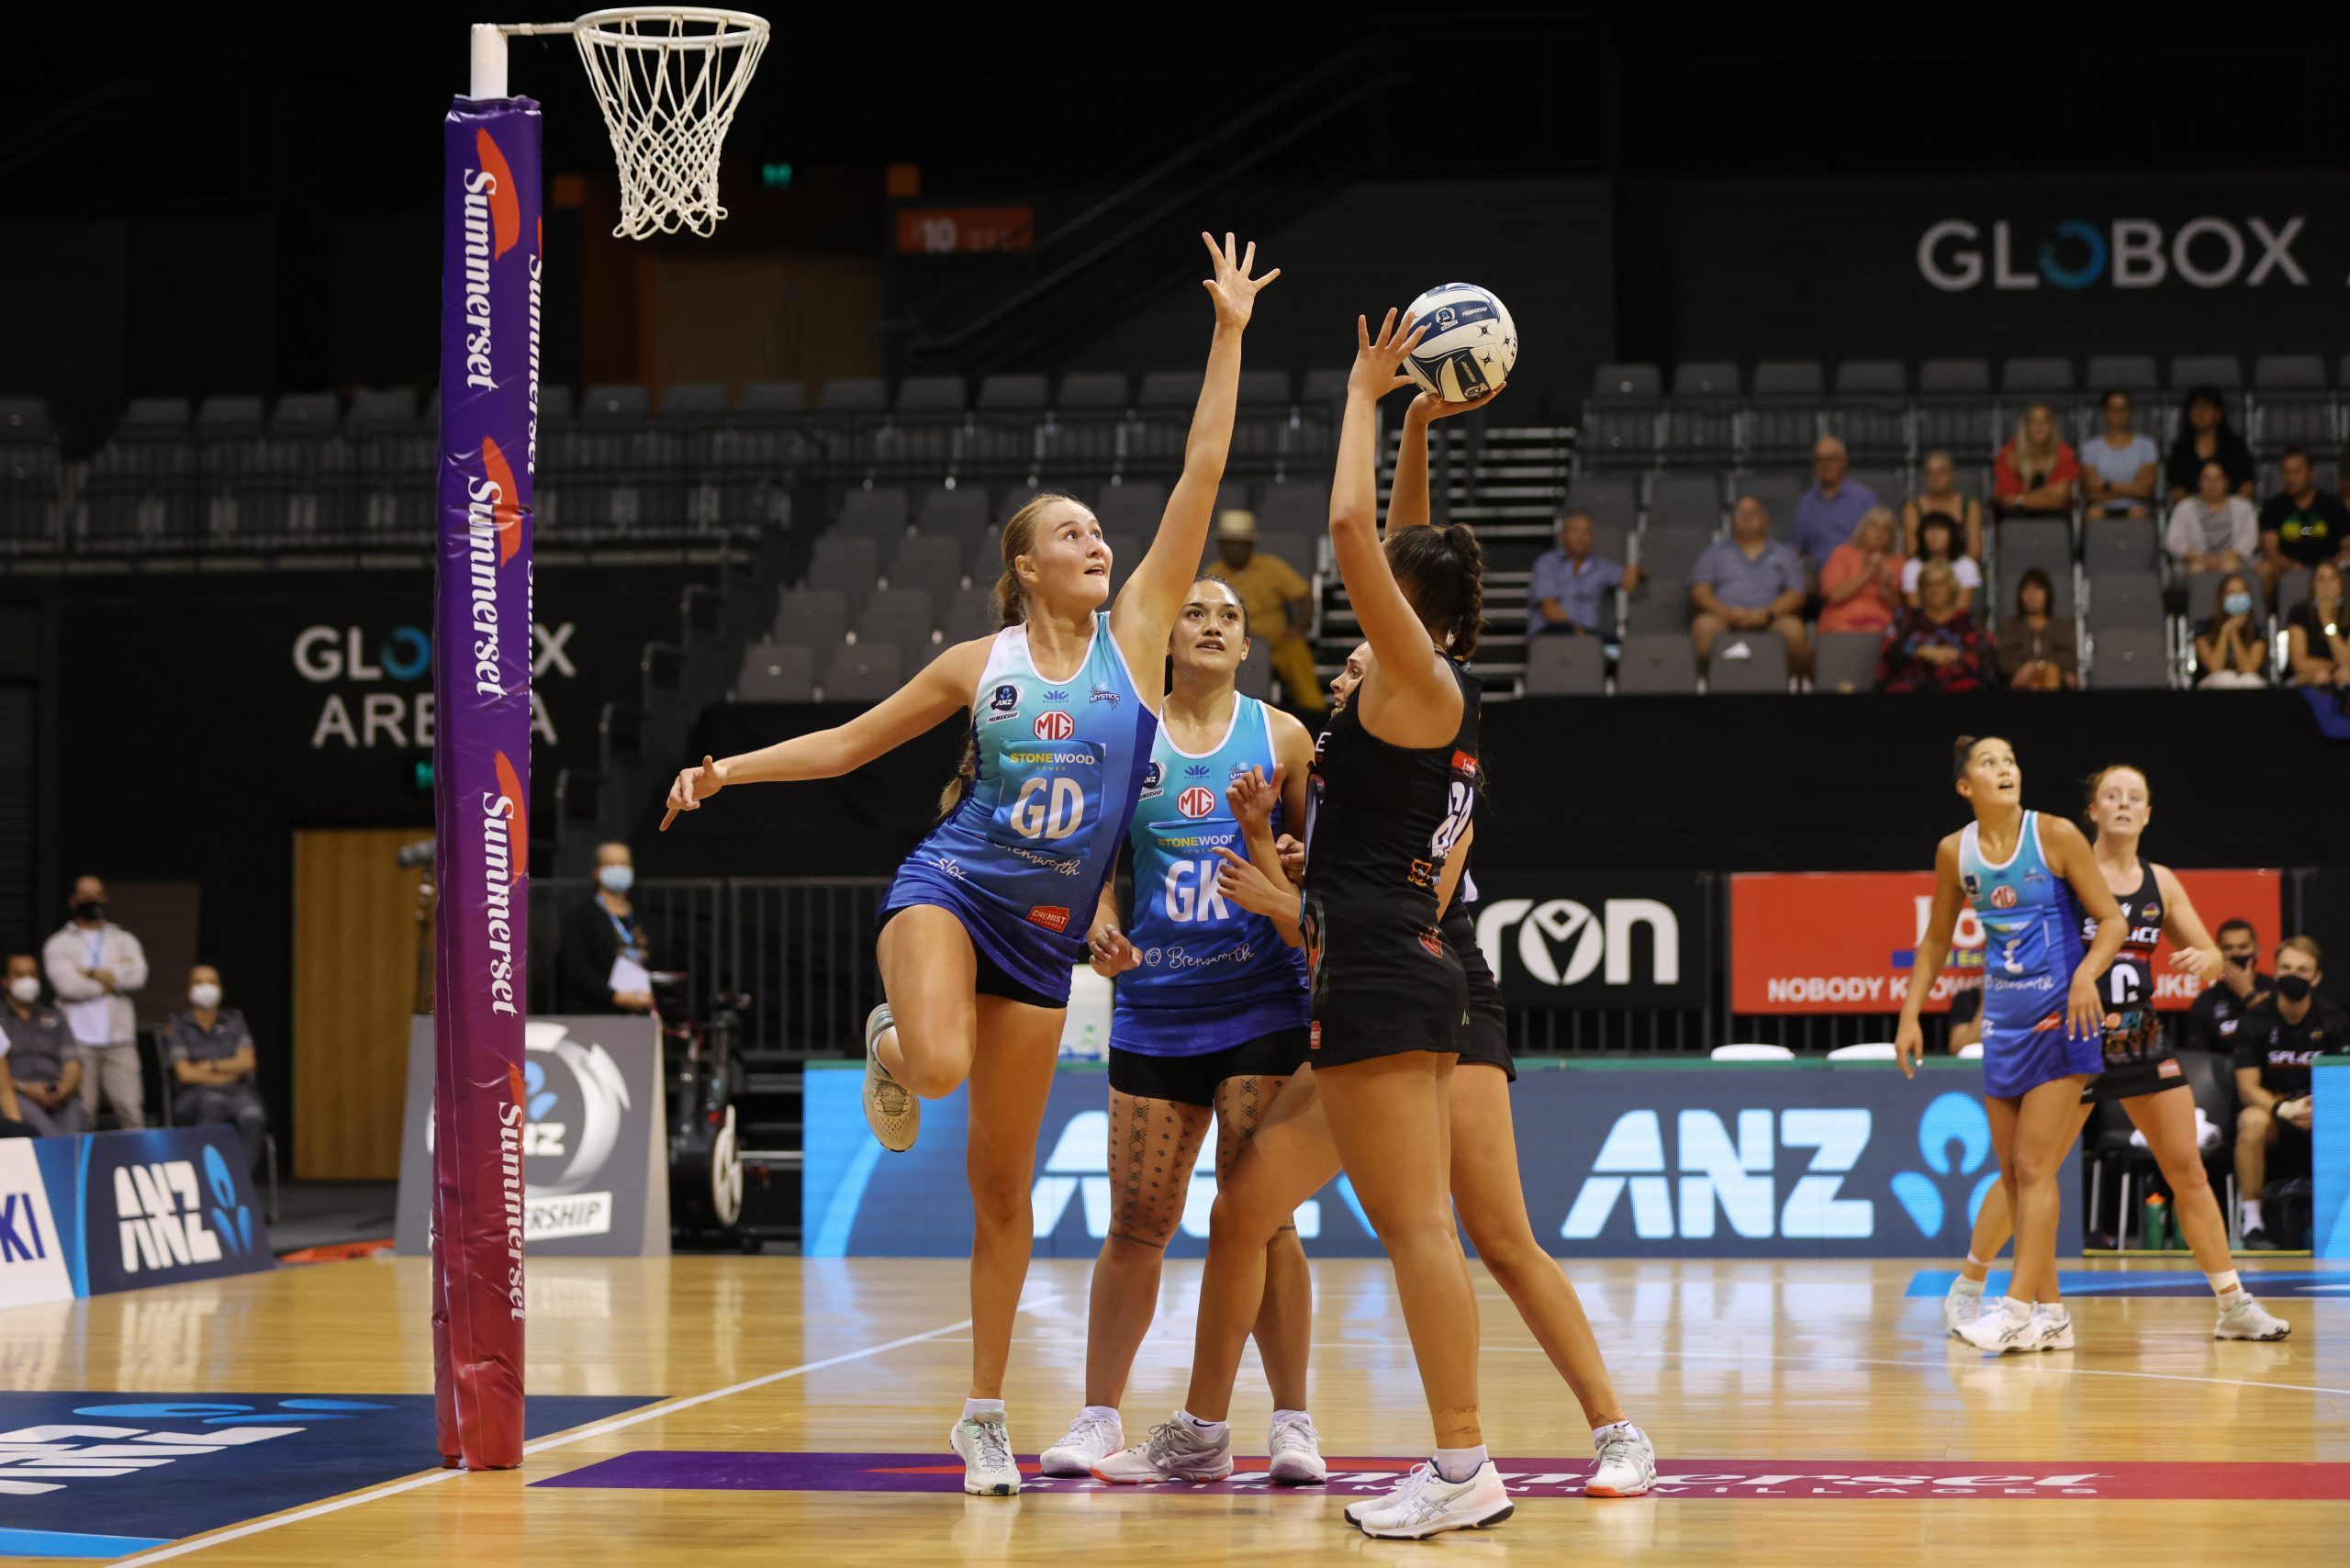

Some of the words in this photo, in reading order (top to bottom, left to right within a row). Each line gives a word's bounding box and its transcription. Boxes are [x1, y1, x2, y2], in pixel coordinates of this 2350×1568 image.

[464, 169, 499, 392] Summerset
[1917, 217, 2310, 291] GLOBOX
[468, 476, 508, 699] Summerset
[292, 623, 577, 683] GLOX
[310, 692, 558, 749] AREA
[987, 712, 1018, 723] PREMIERSHIP
[995, 699, 1013, 707] ANZ
[1036, 712, 1071, 740] MG
[1090, 693, 1120, 703] MYSTICS
[1010, 753, 1095, 766] STONEWOOD
[1010, 777, 1084, 840] GD
[1181, 789, 1213, 816] MG
[482, 791, 519, 1017] Summerset
[1032, 910, 1066, 924] CHEMIST
[1165, 859, 1230, 923] GK
[1768, 977, 1885, 1002] NOBODY
[1561, 1109, 1874, 1238] ANZ
[114, 1160, 222, 1273] ANZ
[498, 1102, 525, 1322] Summerset
